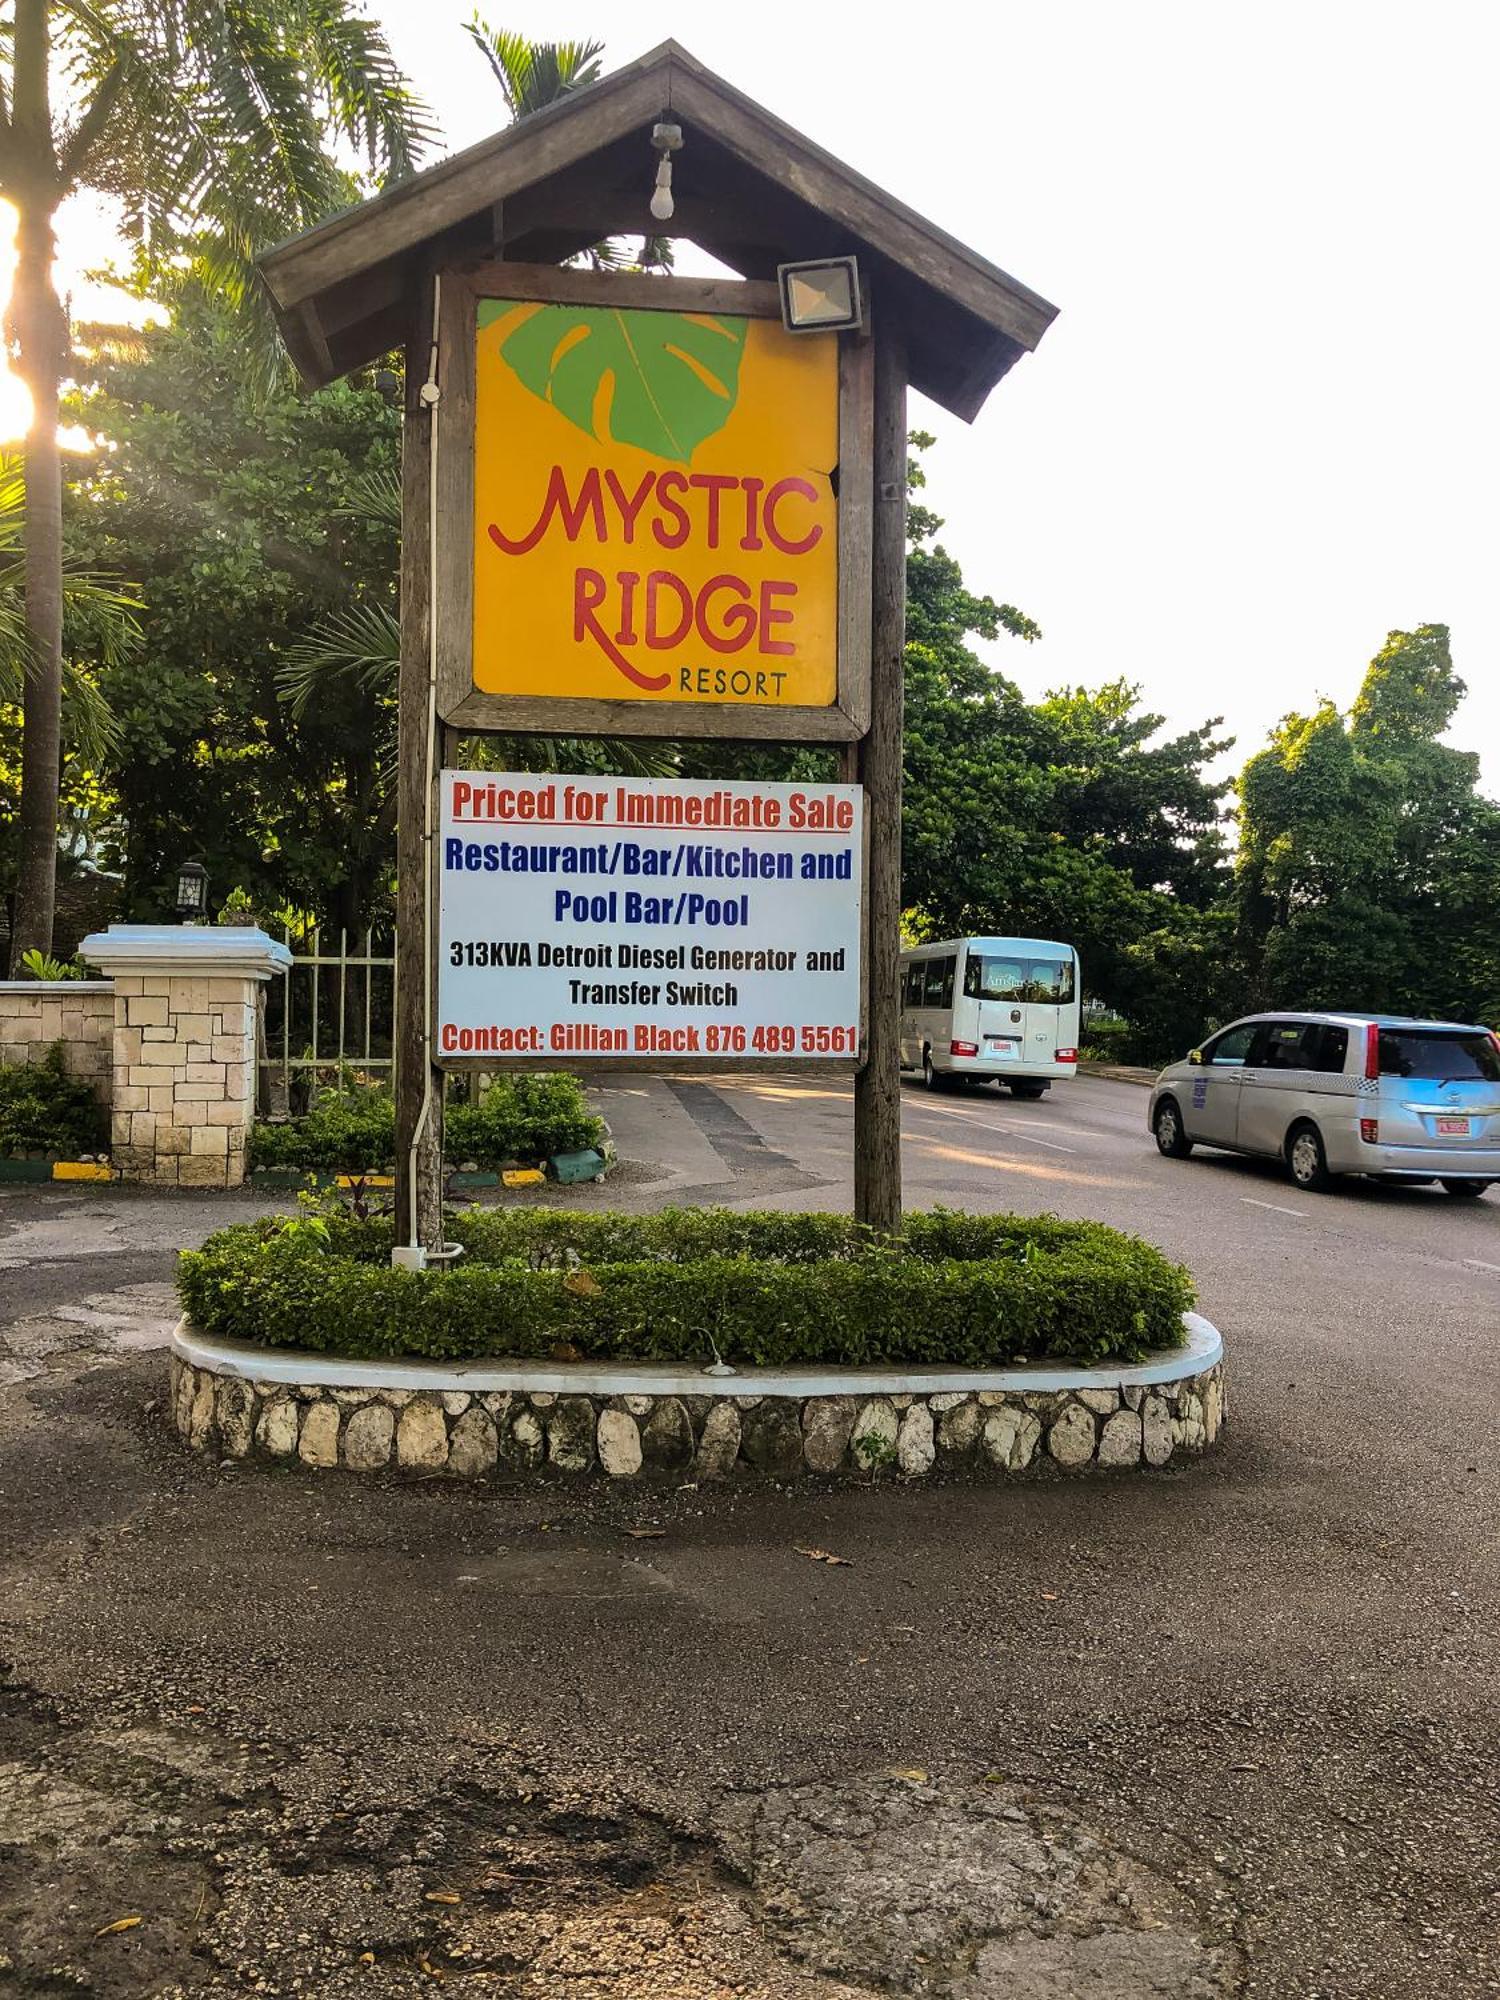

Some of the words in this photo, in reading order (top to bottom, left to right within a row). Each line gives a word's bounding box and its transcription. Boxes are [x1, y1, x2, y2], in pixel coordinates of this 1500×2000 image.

[488, 465, 823, 556] MYSTIC
[574, 568, 798, 691] RIDGE
[680, 668, 787, 697] RESORT
[453, 782, 556, 821] Priced
[564, 786, 608, 822] for
[616, 788, 782, 827] Immediate
[789, 792, 853, 829] Sale
[445, 838, 793, 879] Restaurant/Bar/Kitchen
[801, 848, 852, 880] and
[555, 890, 617, 923] Pool
[625, 892, 749, 926] Bar/Pool
[450, 942, 532, 967] 313KVA
[537, 943, 612, 968] Detroit
[618, 944, 685, 970] Diesel
[691, 946, 797, 971] Generator
[806, 948, 845, 972] and
[569, 980, 661, 1005] Transfer
[666, 981, 738, 1006] Switch
[442, 1024, 545, 1051] Contact:
[550, 1024, 628, 1051] Gillian
[634, 1025, 699, 1052] Black
[706, 1026, 746, 1052] 876
[751, 1026, 796, 1052] 489
[802, 1026, 856, 1053] 5561
